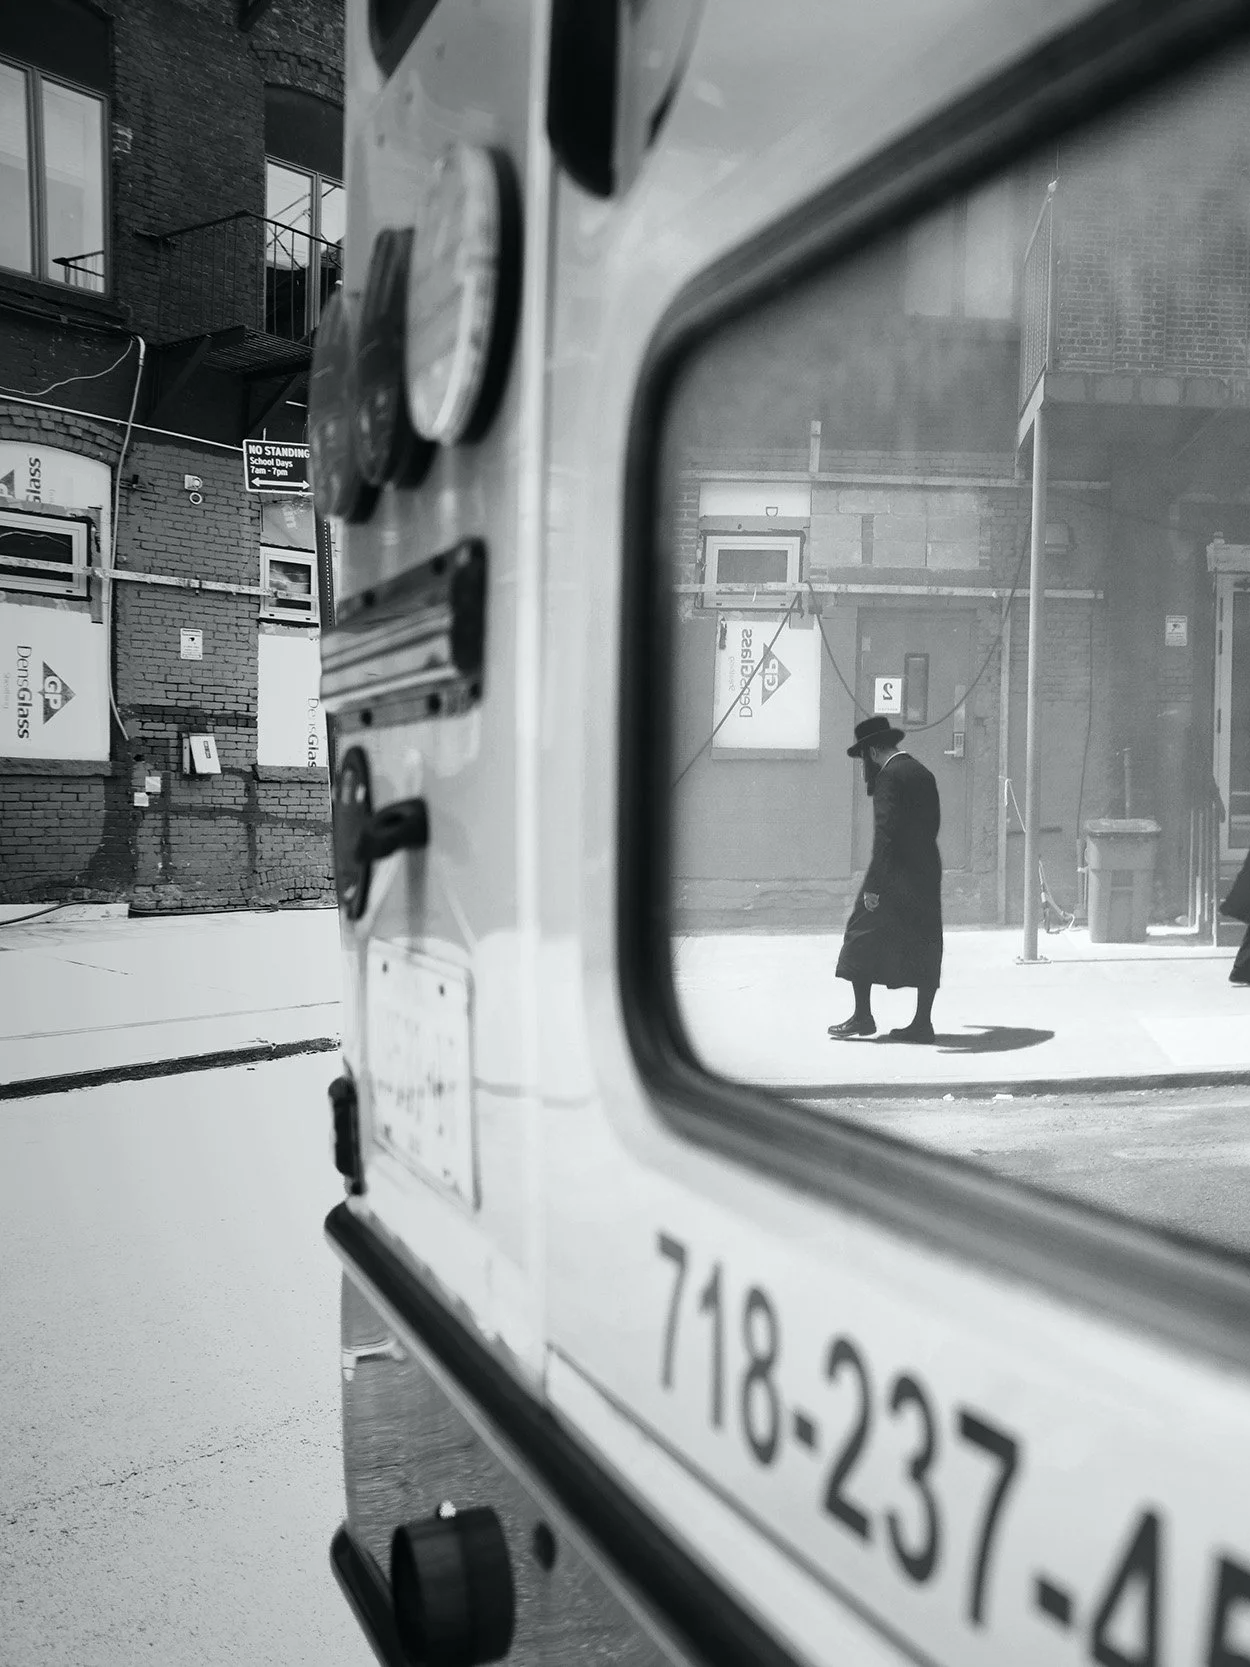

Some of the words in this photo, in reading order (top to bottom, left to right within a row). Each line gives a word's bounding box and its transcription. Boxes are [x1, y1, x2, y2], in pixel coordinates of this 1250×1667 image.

[248, 445, 263, 455] NO
[264, 446, 311, 459] STANDING
[249, 457, 274, 466] School
[275, 458, 294, 469] Days
[250, 466, 267, 475] 7am
[272, 467, 289, 477] 7pm
[17, 645, 33, 739] DensGlass
